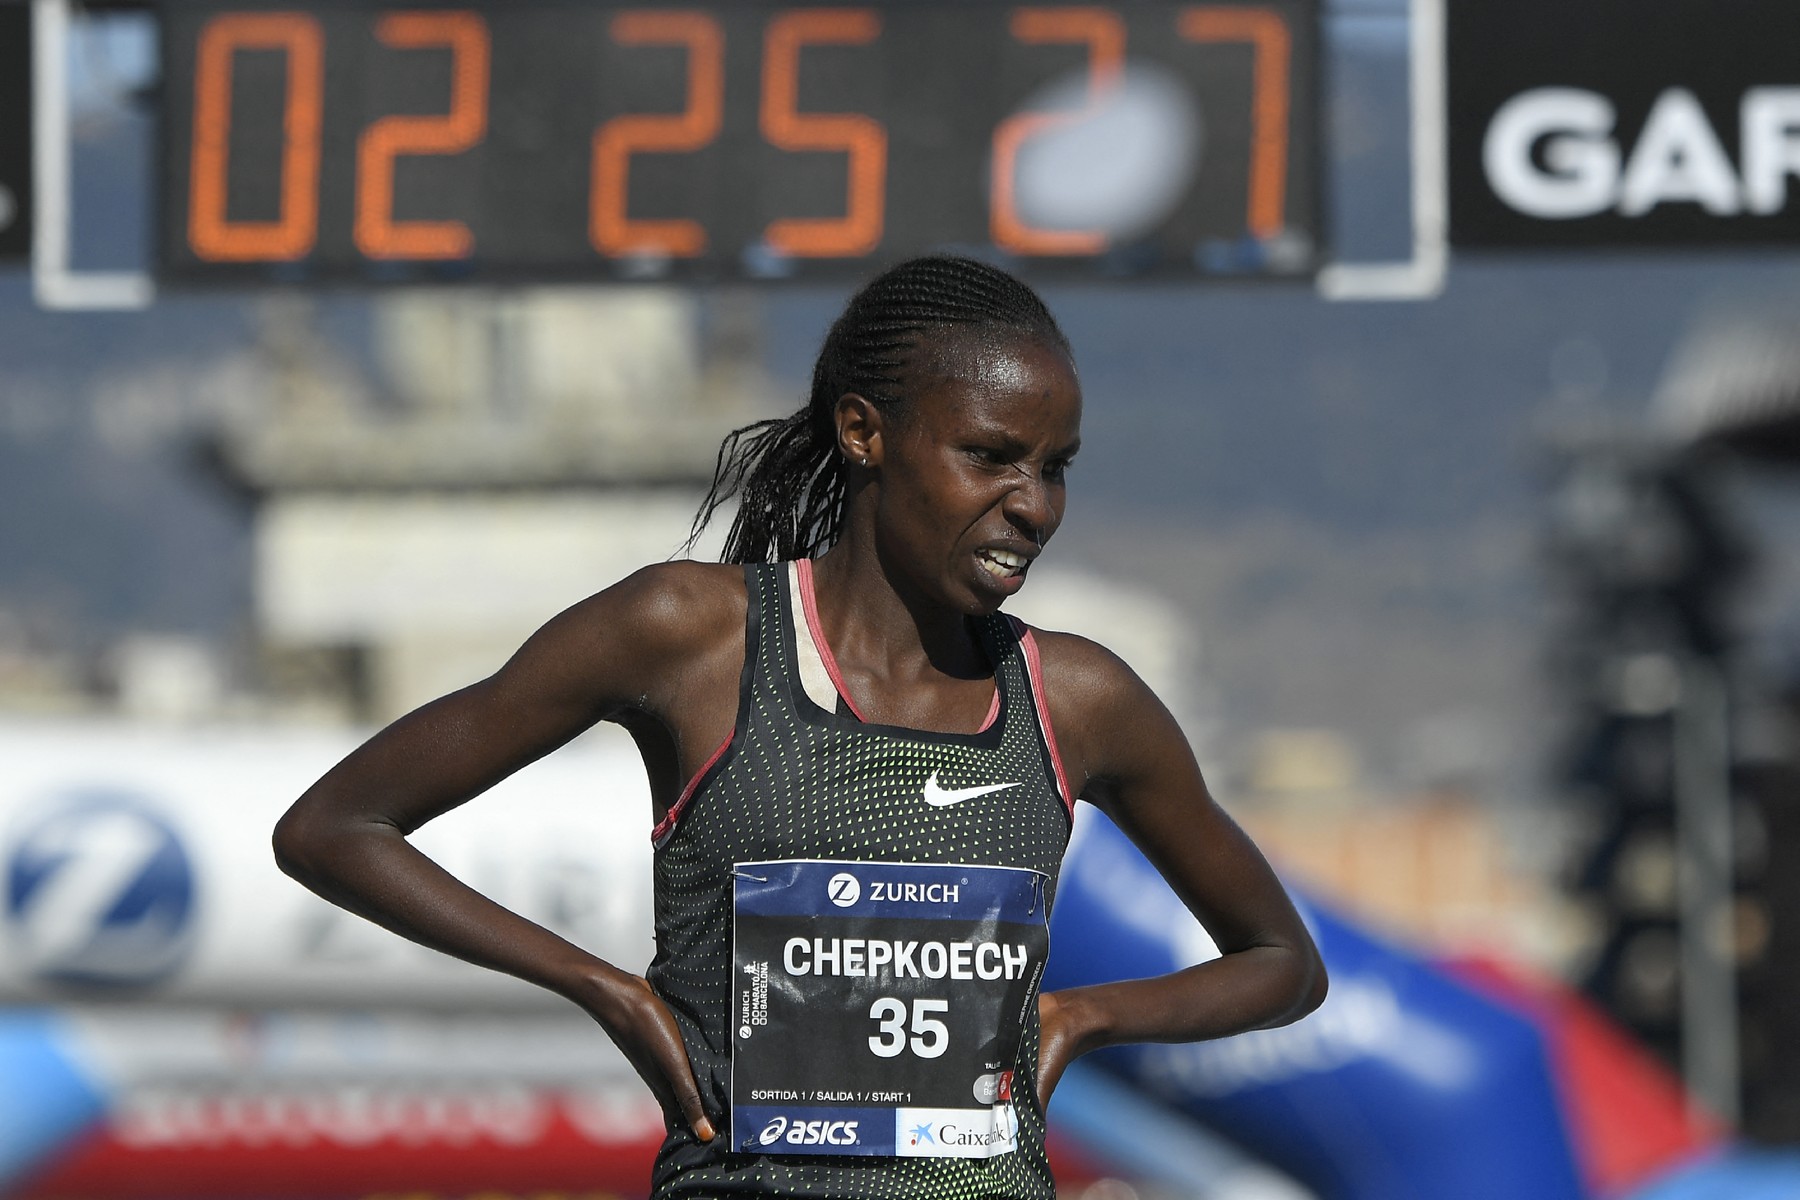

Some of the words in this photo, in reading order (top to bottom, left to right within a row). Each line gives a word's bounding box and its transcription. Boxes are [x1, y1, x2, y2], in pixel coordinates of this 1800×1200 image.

[188, 12, 491, 261] 02
[589, 10, 887, 258] 25
[869, 882, 959, 903] ZURICH
[783, 937, 1028, 980] CHEPKOECH
[760, 961, 768, 1010] BARCELONA
[742, 990, 750, 1025] ZURICH
[868, 997, 949, 1059] 35
[751, 1090, 798, 1100] SORTIDA
[801, 1091, 806, 1100] 1
[816, 1091, 854, 1101] SALIDA
[857, 1092, 861, 1101] 1
[871, 1092, 904, 1102] START
[906, 1093, 911, 1103] 1
